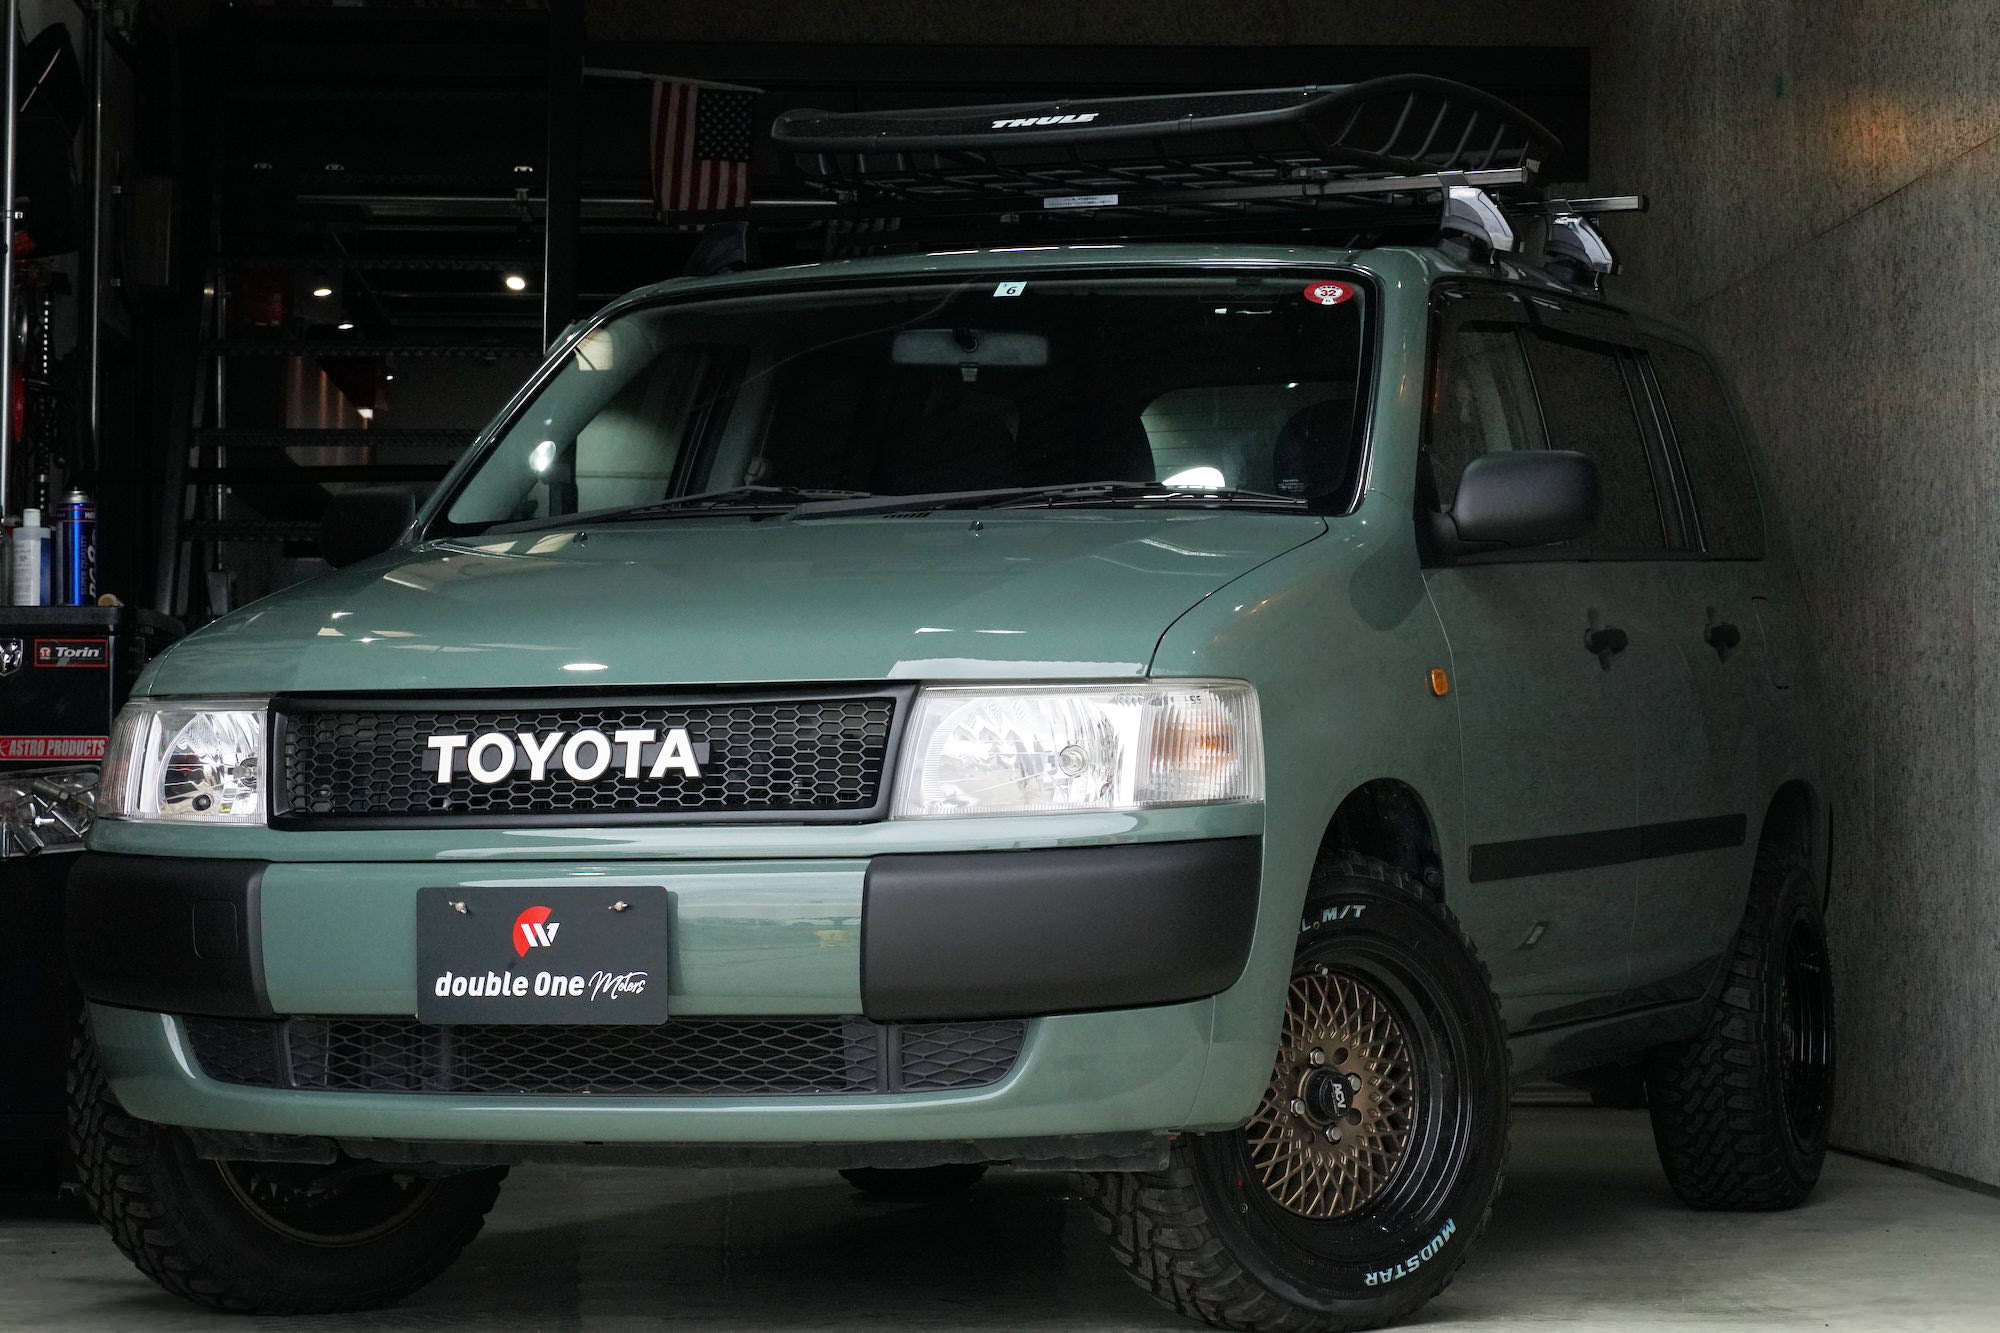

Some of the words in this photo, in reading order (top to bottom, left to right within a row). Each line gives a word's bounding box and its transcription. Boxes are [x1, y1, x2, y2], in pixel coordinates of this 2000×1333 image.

[991, 112, 1100, 129] THULE
[1320, 289, 1337, 297] 32
[56, 646, 100, 658] Torin
[8, 739, 46, 757] ASTRO
[46, 739, 106, 757] PRODUCTS
[427, 728, 702, 785] TOYOTA
[1322, 904, 1367, 923] M/T
[435, 970, 529, 997] double
[534, 970, 585, 997] One
[588, 970, 648, 1001] Motors
[1364, 1217, 1457, 1287] MUDSTAR
